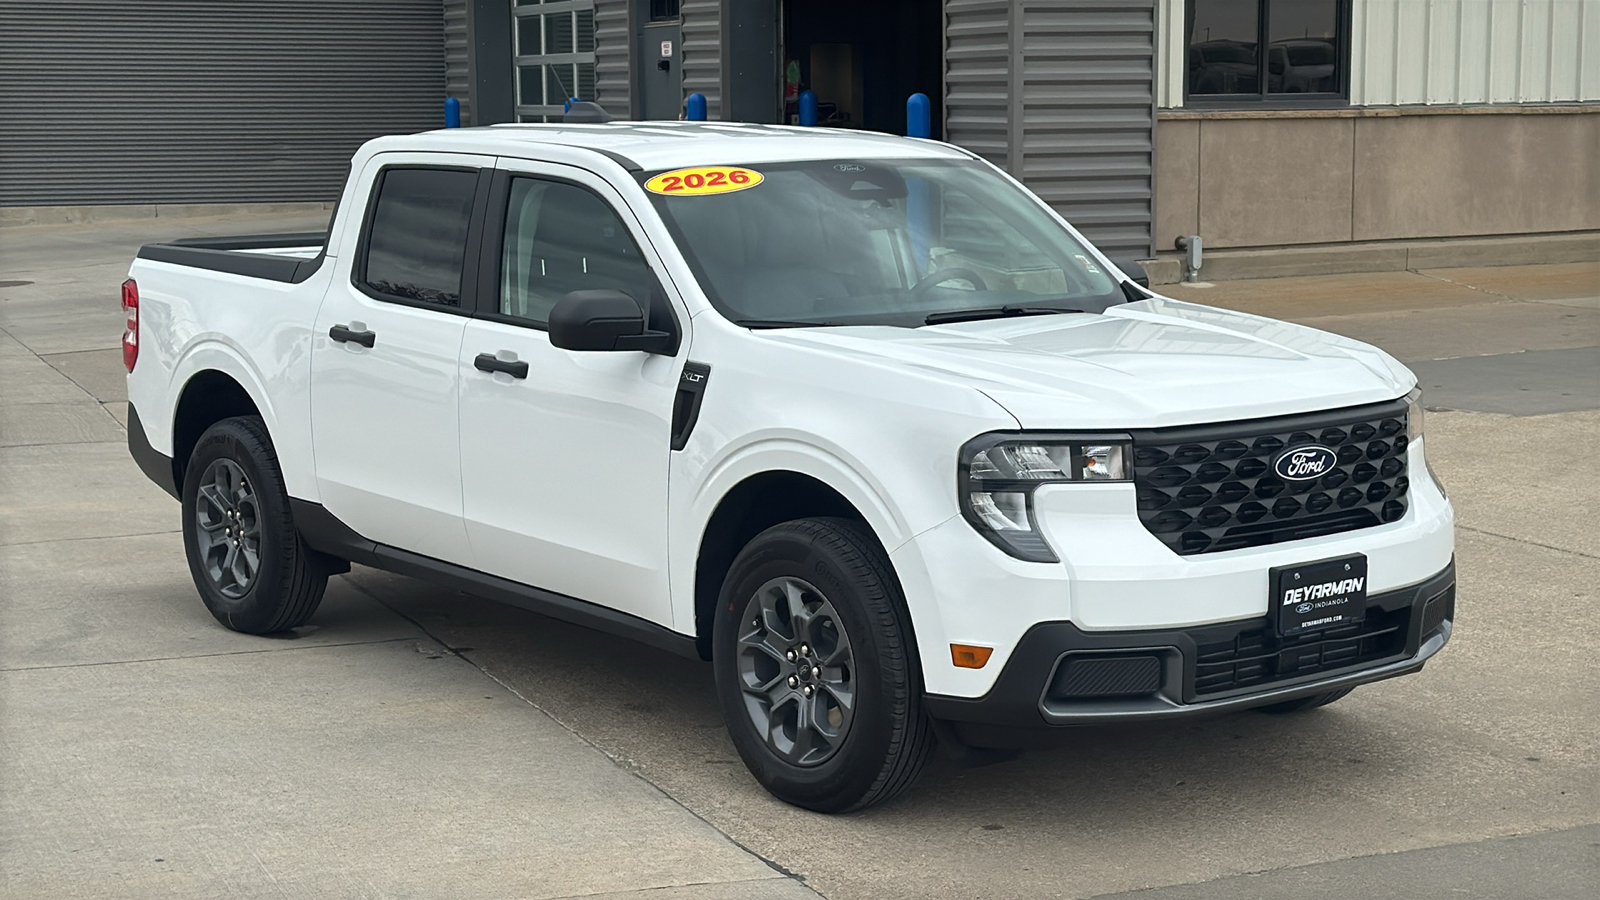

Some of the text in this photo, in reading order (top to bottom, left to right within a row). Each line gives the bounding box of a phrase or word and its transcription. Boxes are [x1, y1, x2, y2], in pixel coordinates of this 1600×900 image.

[661, 170, 750, 192] 2026
[682, 371, 704, 383] XLT
[1287, 451, 1326, 476] Ford
[1283, 576, 1365, 606] DEYARMAN
[1314, 597, 1349, 609] INDIANOLA
